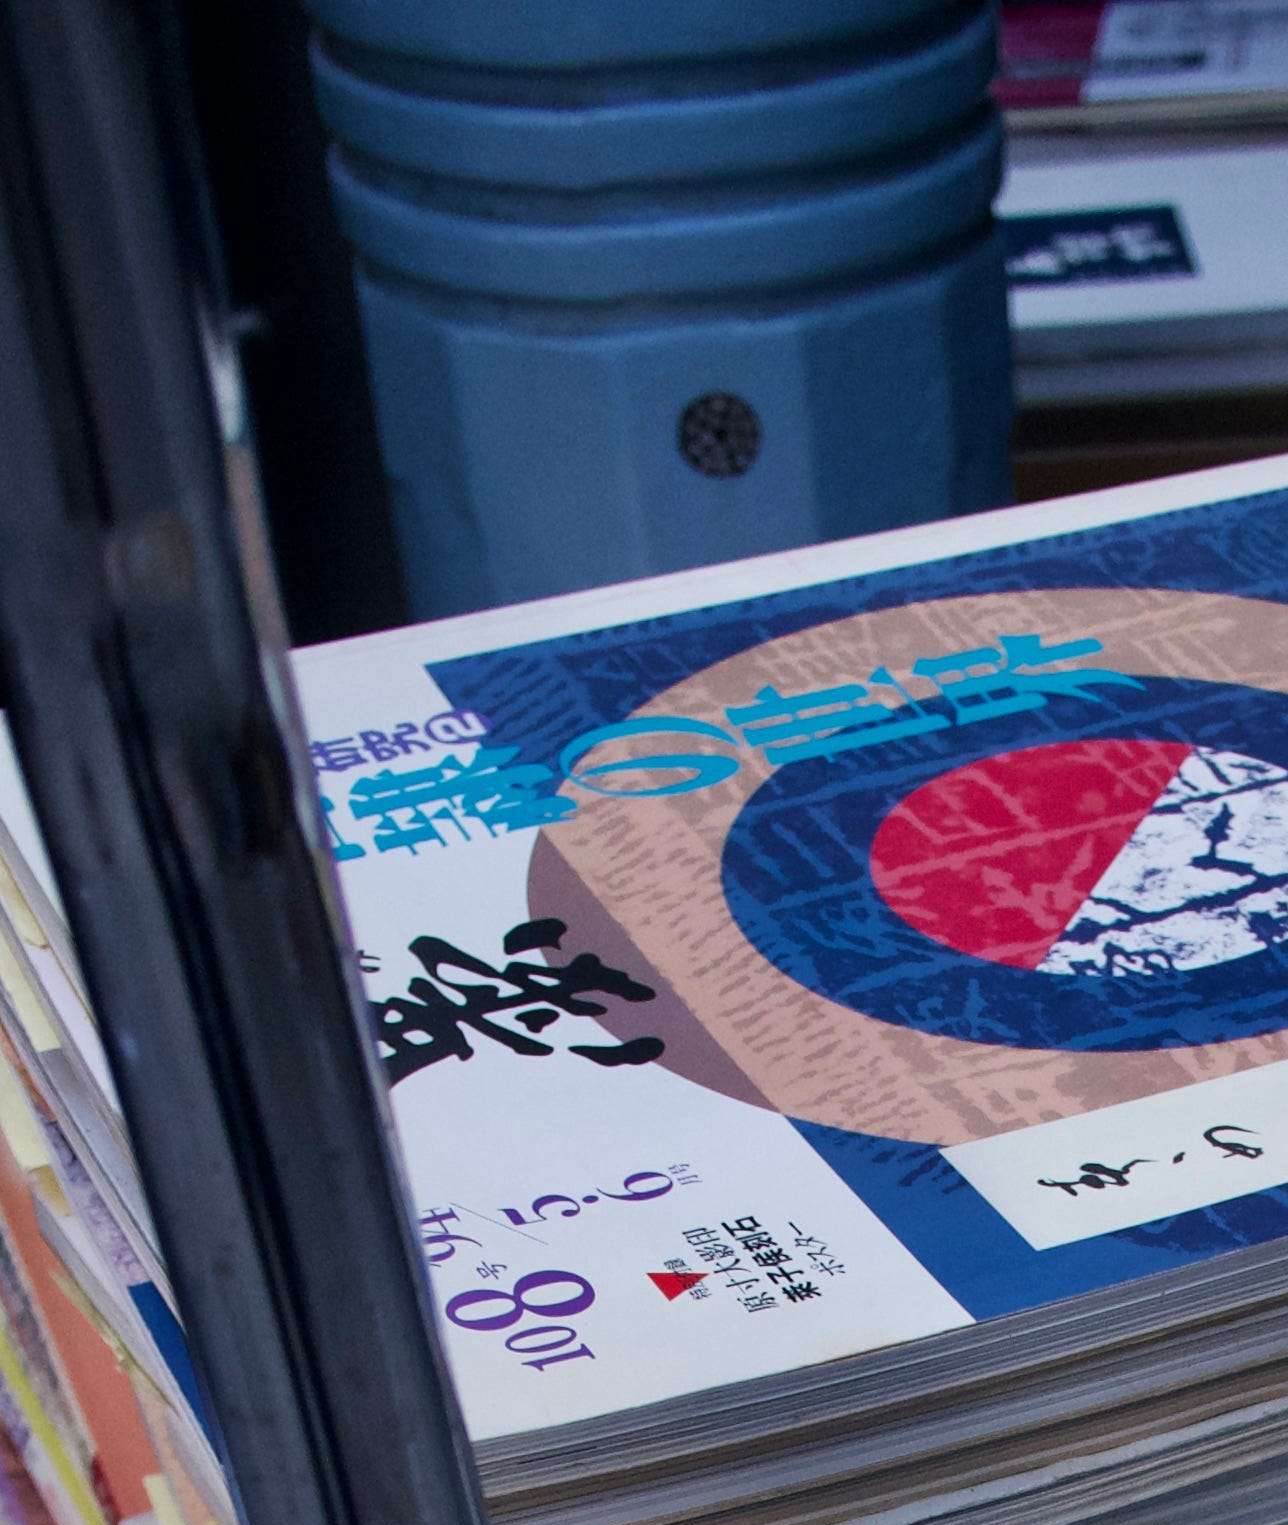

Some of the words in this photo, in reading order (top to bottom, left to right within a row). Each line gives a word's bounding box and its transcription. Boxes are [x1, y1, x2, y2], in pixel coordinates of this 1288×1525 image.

[681, 1225, 776, 1313] 原寸大影印
[787, 1220, 847, 1273] ポスター
